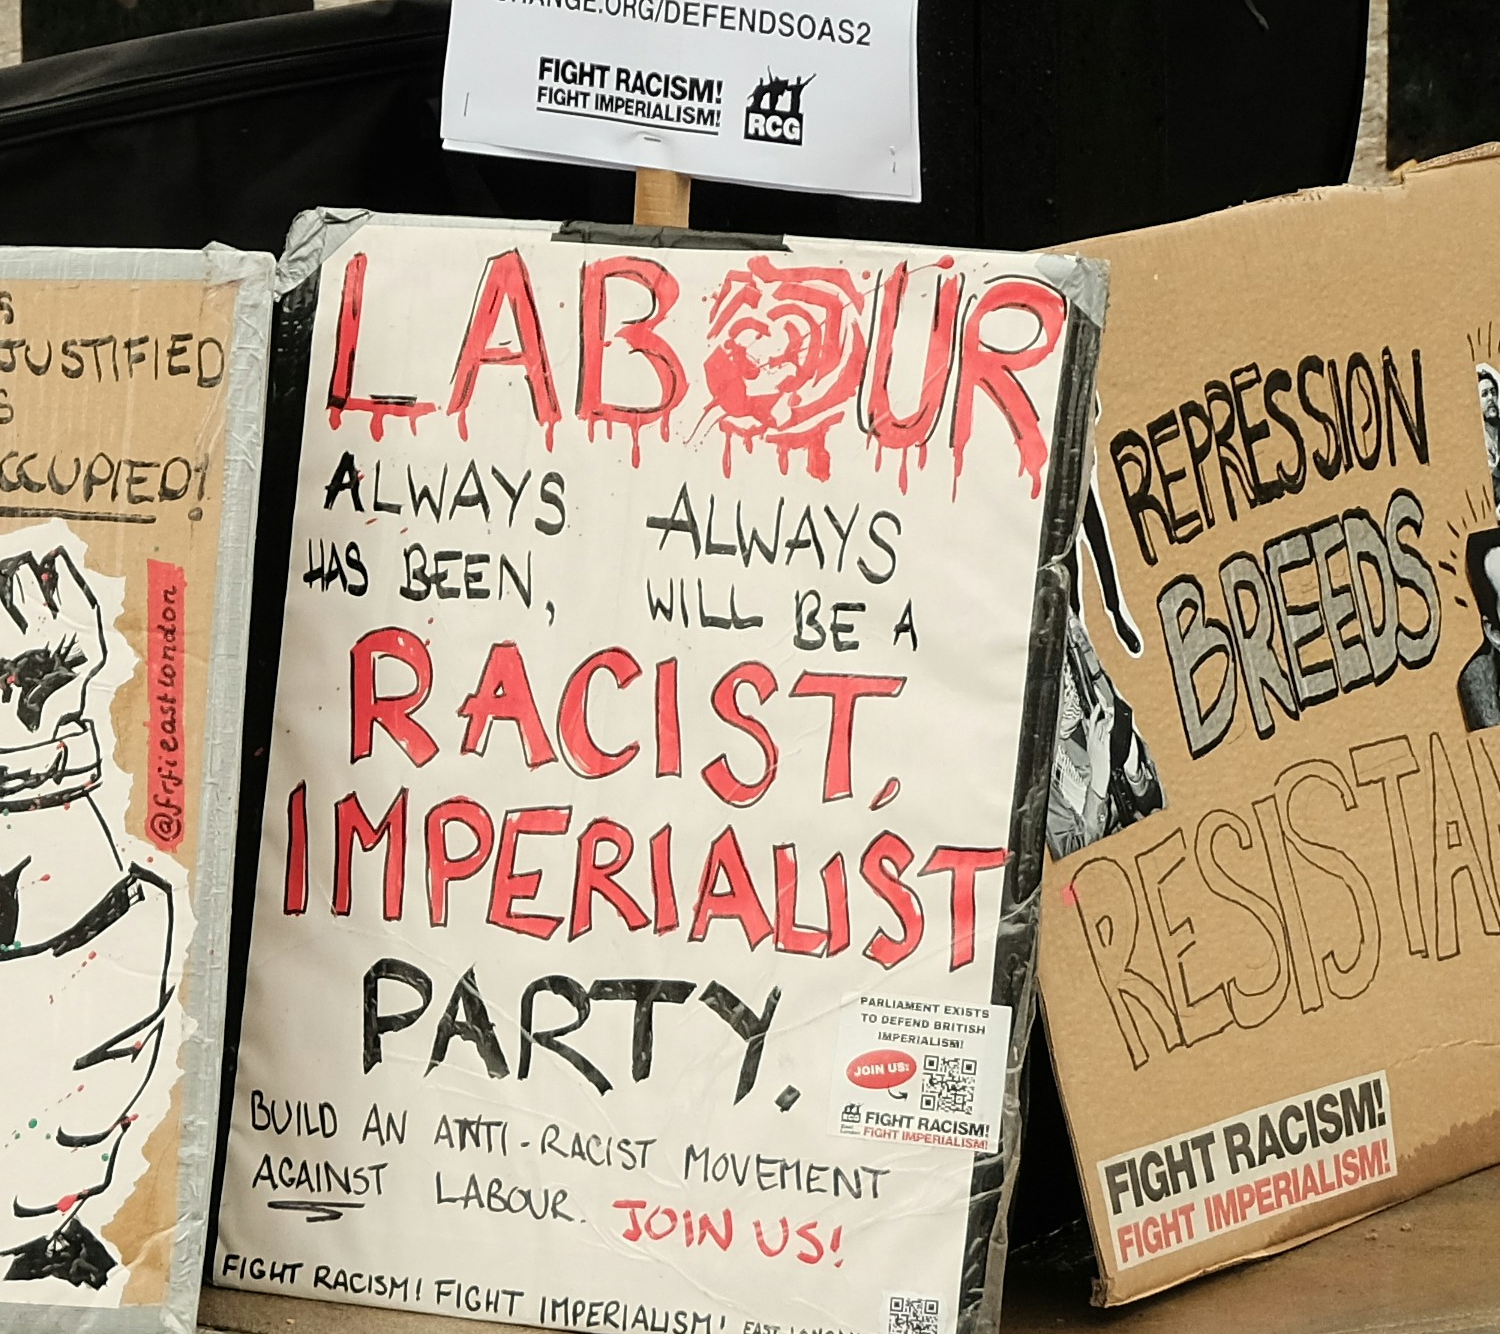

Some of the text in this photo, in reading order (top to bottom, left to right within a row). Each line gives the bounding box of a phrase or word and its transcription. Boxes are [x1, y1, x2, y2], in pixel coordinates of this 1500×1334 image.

[536, 86, 722, 128] FIGHT IMPERIALISM!
[538, 56, 724, 104] FIGHT RACISM!
[748, 116, 800, 140] RCG
[327, 246, 1069, 492] LABOUR
[1108, 345, 1431, 567] REPRESSION
[322, 451, 902, 585] ALWAYS ALWAYS
[302, 538, 919, 652] HAS BEEN, WILL BE A
[1155, 486, 1442, 761] BREEDS
[150, 584, 183, 843] @frfieastlondon
[348, 626, 907, 812] RACIST,
[283, 783, 1009, 971] IMPERIALIST
[362, 957, 802, 1115] PARTY.
[860, 996, 990, 1018] PARLIAMENT EXISTS
[861, 1013, 986, 1035] TO DEFEND BRITISH
[878, 1031, 964, 1049] IMPERIALISM!
[854, 1063, 885, 1077] JOIN
[865, 1111, 990, 1138] FIGHT RACISM!
[250, 1089, 338, 1138] BUILD
[362, 1103, 408, 1146] AN
[684, 1144, 891, 1199] MOVEMENT
[863, 1126, 988, 1150] FIGHT IMPERIALISM!
[1104, 1078, 1387, 1215] FIGHT RACISM!
[252, 1153, 843, 1268] AGAINST LABOUR. JOIN US!
[1116, 1138, 1391, 1264] FIGHT IMPERIALISM!
[222, 1254, 304, 1284] FIGHT
[313, 1265, 422, 1302] RACISM!
[435, 1279, 524, 1316] FIGHT
